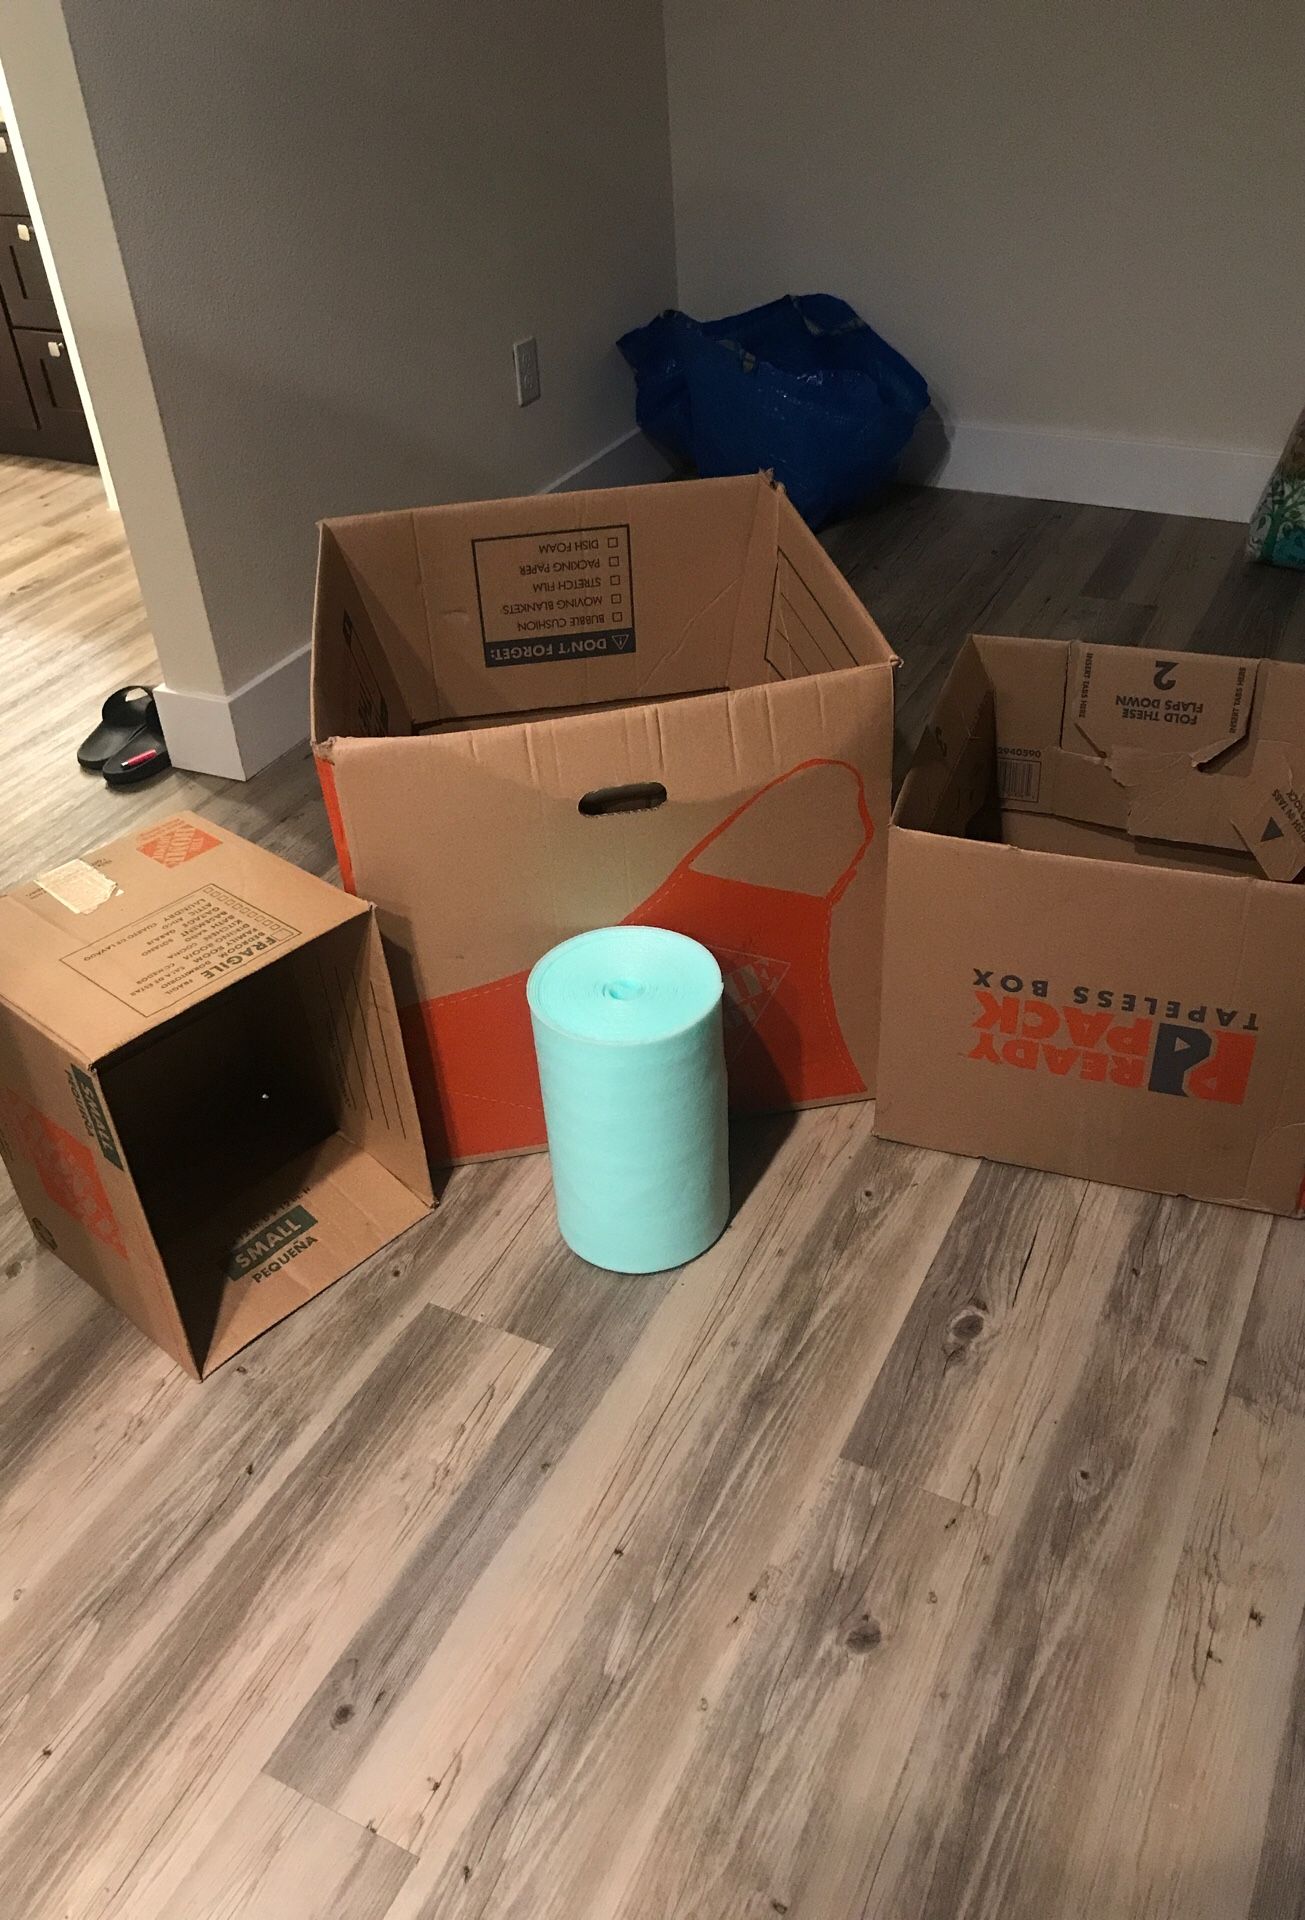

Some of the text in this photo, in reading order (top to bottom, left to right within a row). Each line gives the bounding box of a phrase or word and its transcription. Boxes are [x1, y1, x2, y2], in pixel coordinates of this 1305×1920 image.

[539, 539, 599, 554] DISH FOAM
[519, 559, 600, 576] PACKING PAPER
[532, 577, 601, 593] STRETCH FILM
[502, 596, 603, 615] MOVING BLANKETS
[517, 614, 605, 632] BUBBLE CUSHION
[490, 638, 607, 661] DON'T FORGET:
[1084, 653, 1094, 679] INSERT
[1153, 660, 1180, 691] 2
[1116, 695, 1203, 713] FLAPS DOWN
[1122, 708, 1198, 726] FOLD THESE
[198, 935, 278, 980] FRAGILE
[216, 931, 266, 958] BEDROOM
[972, 968, 1259, 1031] TAPELESS BOX
[971, 990, 1153, 1055] PACK
[967, 1033, 1147, 1089] READY
[234, 1219, 302, 1268] SMALL
[251, 1235, 319, 1284] PEQUEÑA
